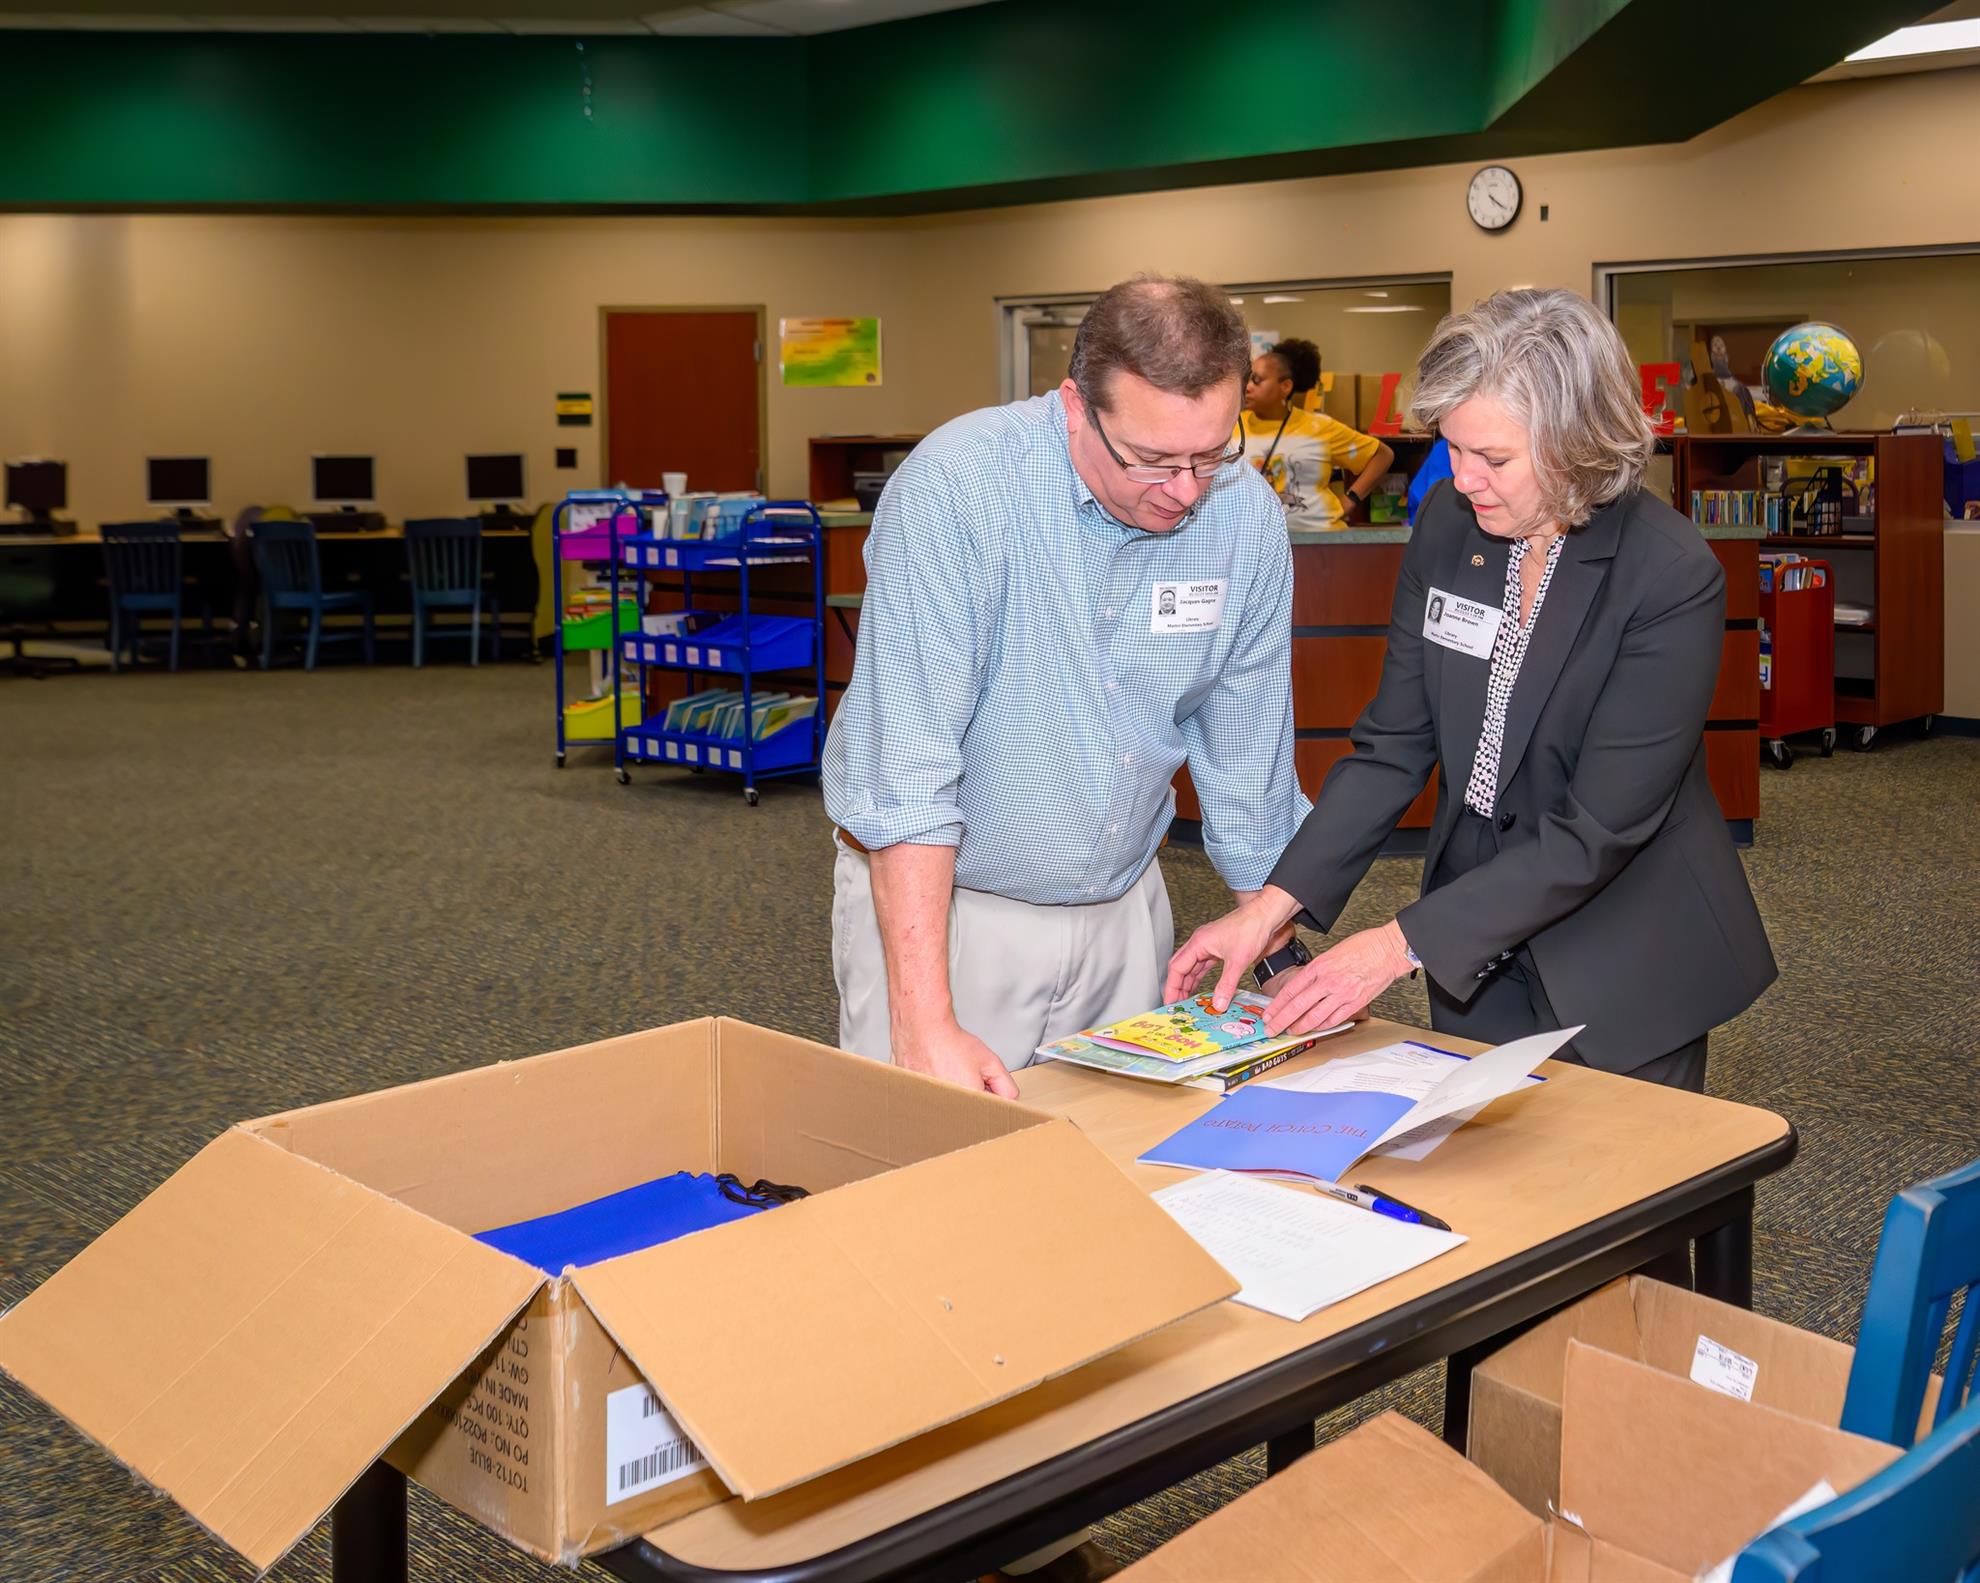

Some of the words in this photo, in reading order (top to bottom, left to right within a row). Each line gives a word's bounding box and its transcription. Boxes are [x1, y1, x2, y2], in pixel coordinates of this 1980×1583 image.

[1456, 602, 1485, 616] VISITOR
[508, 1360, 529, 1385] GW:
[486, 1377, 496, 1396] IN
[499, 1383, 529, 1412] MADE
[486, 1403, 502, 1426] 100
[506, 1412, 529, 1439] QTY:
[513, 1444, 529, 1466] PO
[469, 1447, 529, 1493] TOT12-BLUE
